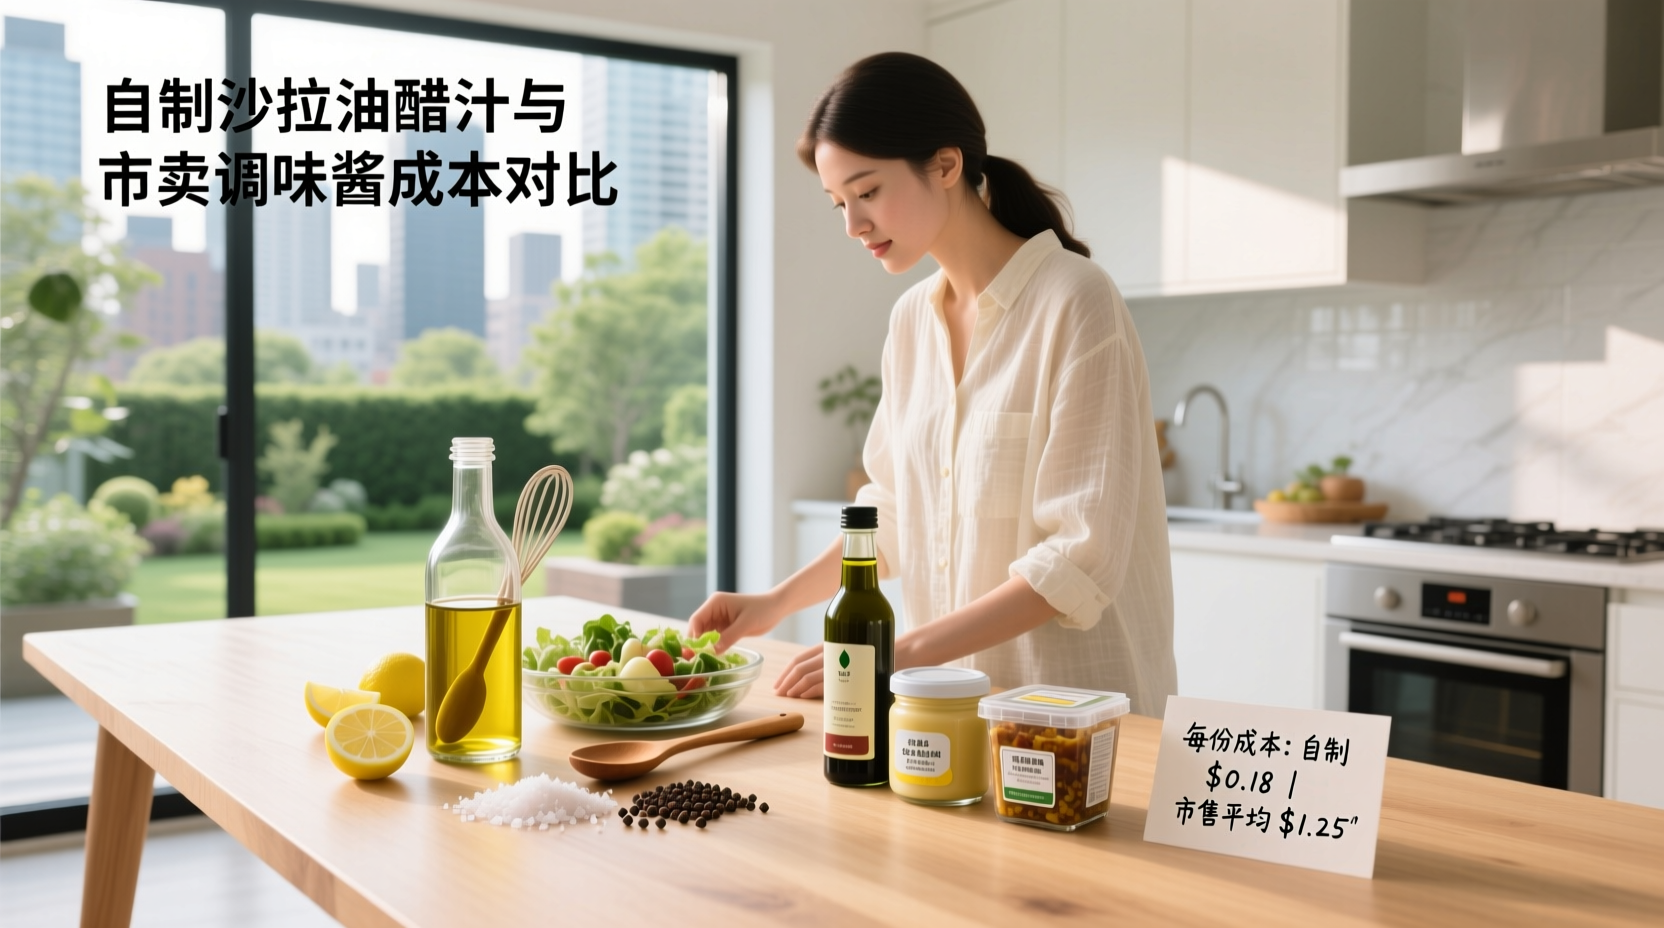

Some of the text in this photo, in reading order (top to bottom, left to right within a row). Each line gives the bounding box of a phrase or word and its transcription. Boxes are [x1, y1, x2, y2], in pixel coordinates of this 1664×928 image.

[1303, 734, 1350, 767] 自制
[1206, 760, 1274, 794] $0.18
[1175, 796, 1271, 833] 市售平均
